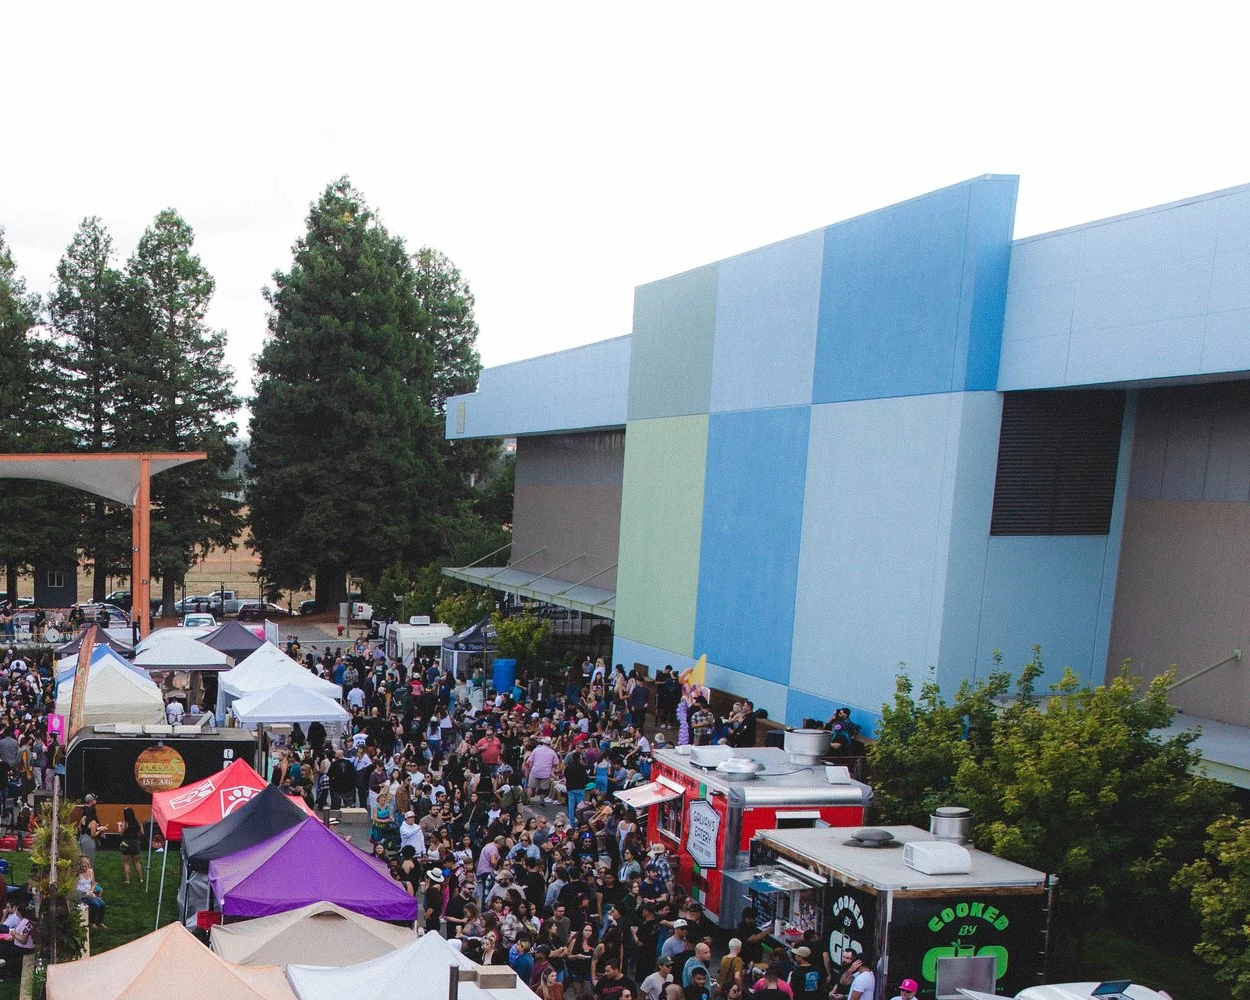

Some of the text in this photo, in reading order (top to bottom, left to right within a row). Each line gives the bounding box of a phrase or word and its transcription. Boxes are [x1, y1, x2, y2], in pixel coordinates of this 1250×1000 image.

[832, 895, 865, 930] COOKED
[927, 902, 1010, 933] COOKED
[958, 925, 978, 937] BY
